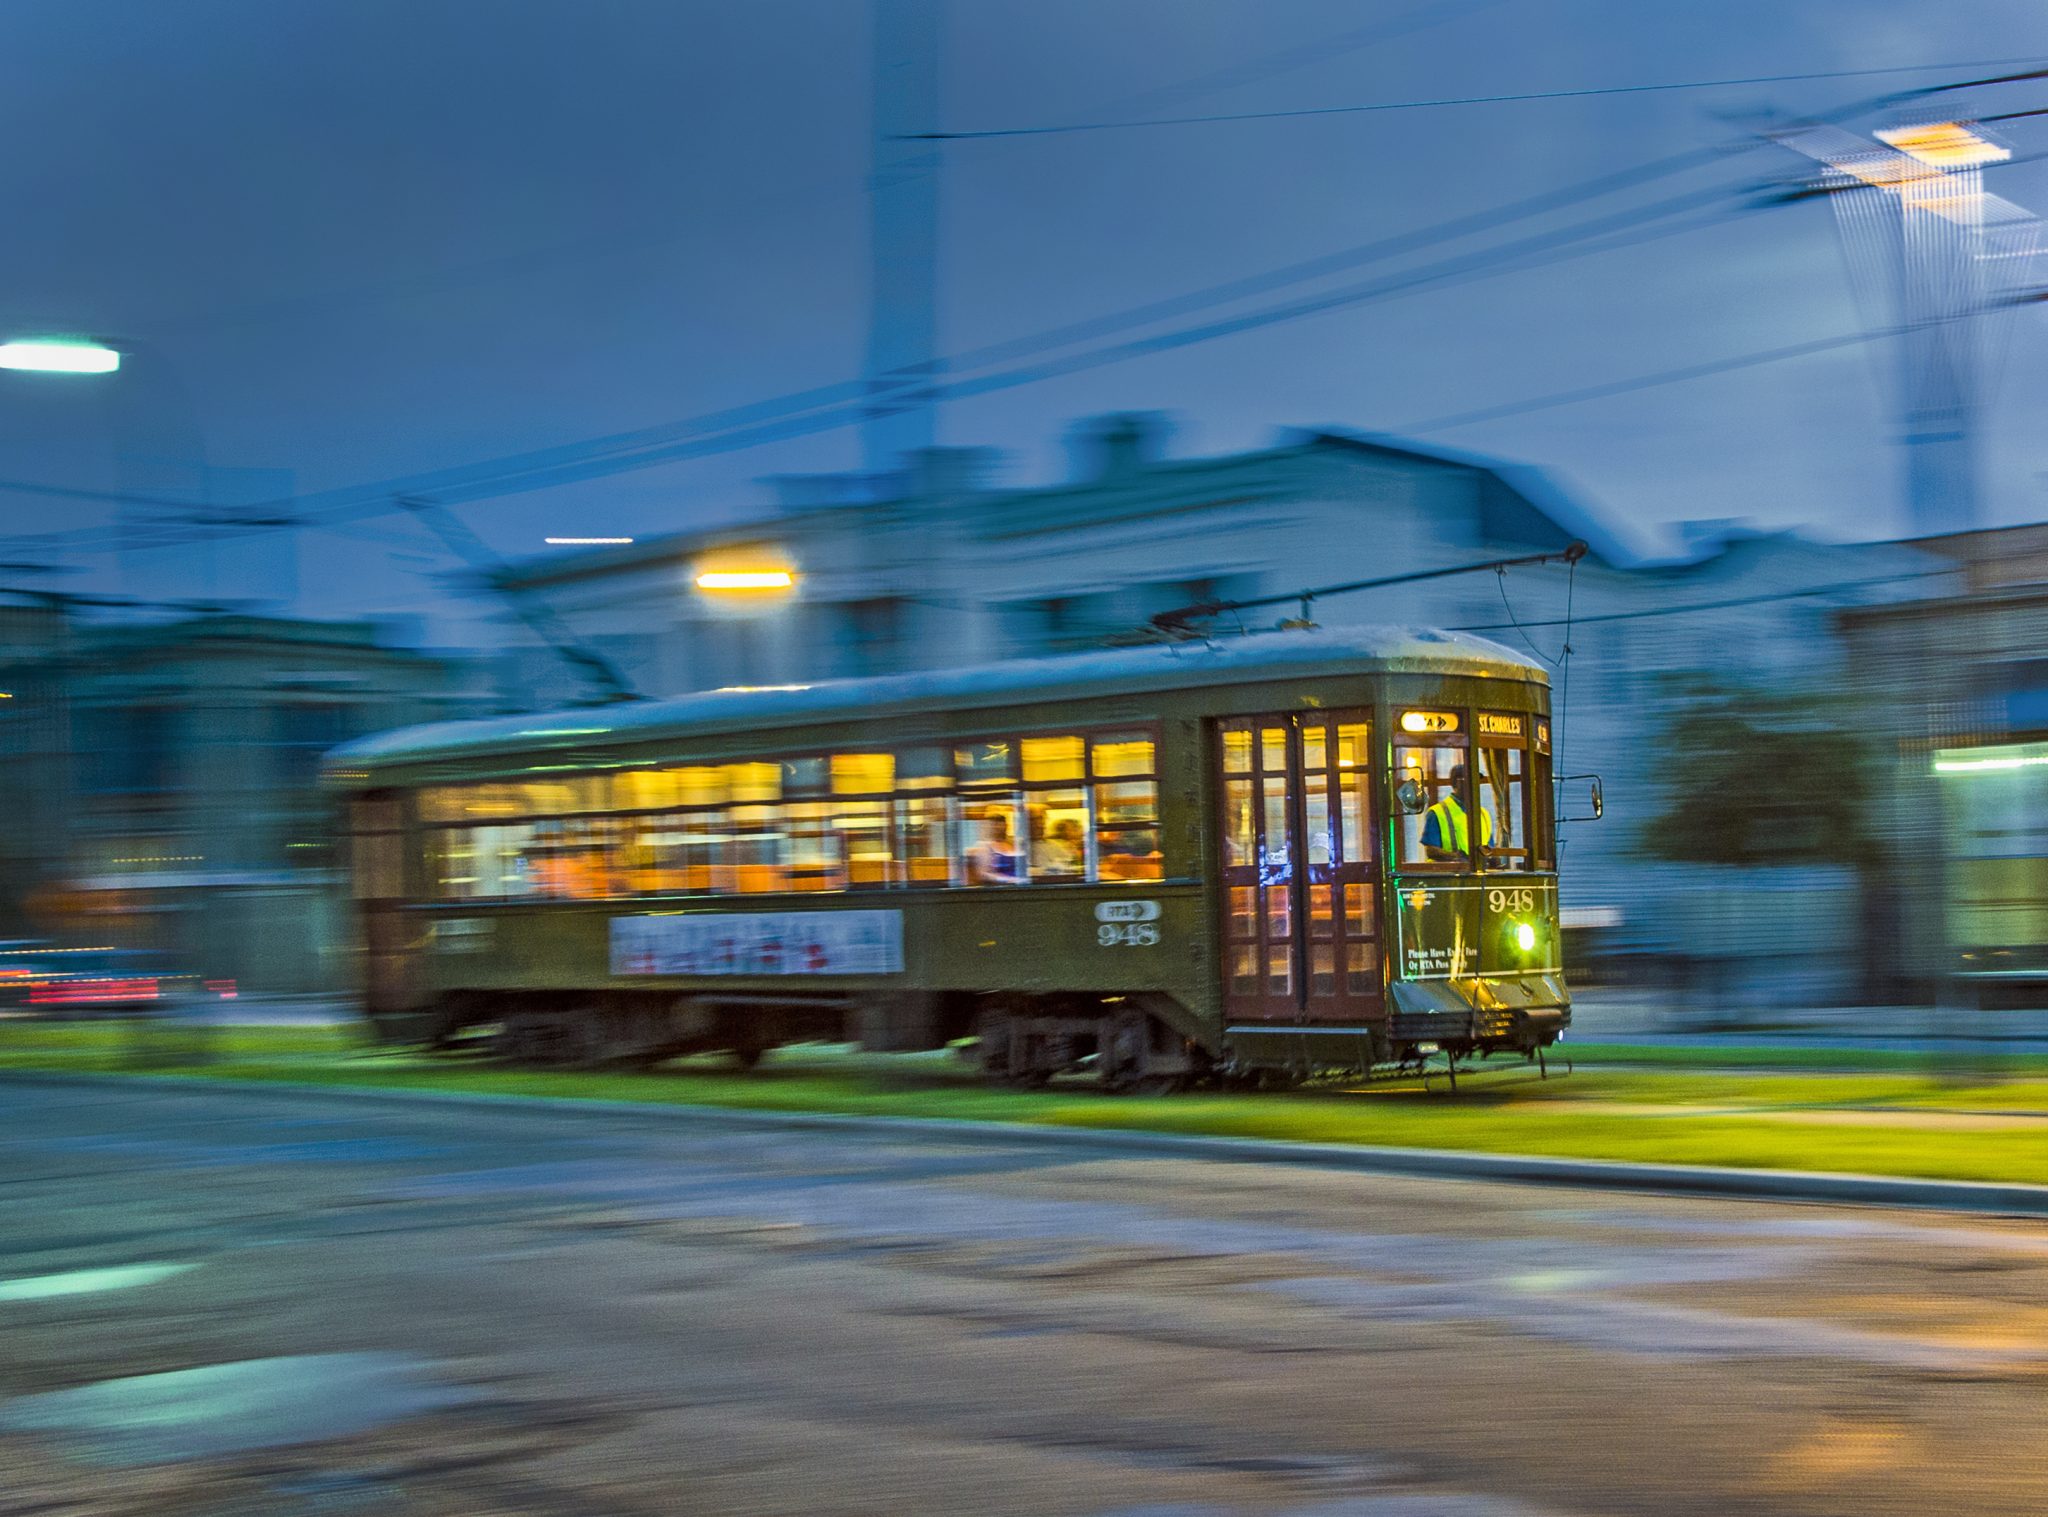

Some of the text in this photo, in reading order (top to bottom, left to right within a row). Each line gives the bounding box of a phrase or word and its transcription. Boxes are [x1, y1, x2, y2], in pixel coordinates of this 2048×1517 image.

[1489, 715, 1520, 734] CHARLES
[1489, 889, 1534, 913] 948
[1097, 923, 1160, 946] 948
[1408, 949, 1428, 958] Please
[1430, 948, 1445, 957] Have
[1419, 960, 1434, 969] RTA
